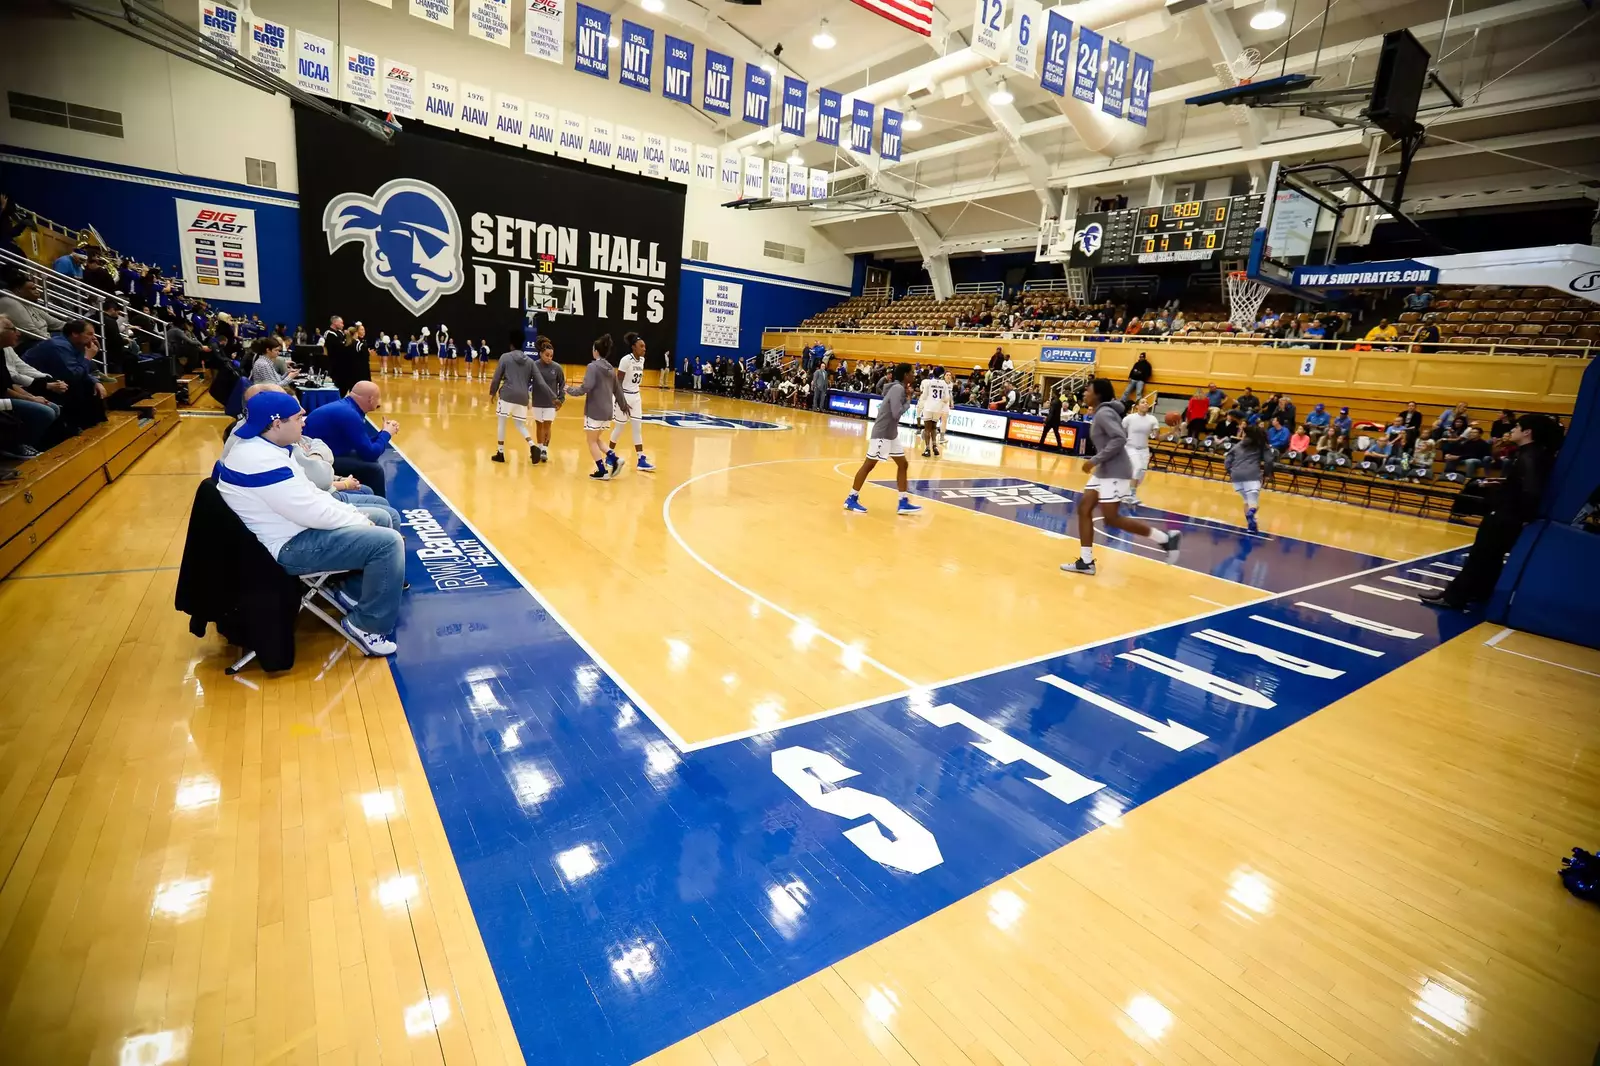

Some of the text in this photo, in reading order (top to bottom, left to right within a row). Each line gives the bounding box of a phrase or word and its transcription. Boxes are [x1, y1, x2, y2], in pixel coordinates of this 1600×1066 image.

[216, 6, 237, 23] BIG
[425, 9, 440, 21] 1993
[478, 7, 504, 23] BASKETBALL
[484, 3, 498, 14] MEN'S
[531, 2, 563, 17] EAST
[982, 0, 1001, 31] 12
[204, 14, 237, 34] EAST
[264, 22, 284, 39] BIG
[585, 17, 602, 31] 1941
[1019, 14, 1031, 46] 6
[253, 29, 284, 49] EAST
[578, 25, 607, 61] NIT
[630, 33, 646, 46] 1951
[977, 34, 997, 51] BROOKS
[1051, 30, 1067, 65] 12
[303, 41, 326, 55] 2014
[671, 48, 687, 61] 1952
[358, 54, 375, 67] BIG
[576, 55, 607, 72] FINAL FOUR
[623, 41, 650, 75] NIT
[1078, 43, 1098, 78] 24
[298, 57, 330, 83] NCAA
[348, 60, 375, 77] EAST
[391, 67, 411, 77] BIG
[711, 61, 727, 74] 1953
[1108, 57, 1125, 89] 34
[387, 72, 414, 83] EAST
[621, 69, 650, 86] FINAL FOUR
[666, 65, 691, 97] NIT
[706, 69, 730, 100] NIT
[1078, 75, 1095, 89] TERRY
[1133, 68, 1149, 97] 44
[297, 79, 330, 94] VOLLEYBALL
[425, 96, 454, 118] AIAW
[745, 91, 768, 120] NIT
[461, 105, 488, 127] AIAW
[783, 103, 805, 131] NIT
[496, 115, 522, 135] AIAW
[529, 123, 553, 143] AIAW
[819, 114, 839, 141] NIT
[560, 131, 583, 150] AIAW
[852, 123, 871, 149] NIT
[882, 132, 900, 157] NIT
[589, 138, 612, 157] AIAW
[616, 145, 639, 163] AIAW
[643, 145, 664, 163] NCAA
[669, 157, 690, 174] NCAA
[696, 163, 715, 179] NIT
[721, 168, 739, 184] NIT
[745, 173, 763, 188] WNIT
[769, 174, 786, 186] WNIT
[790, 182, 806, 196] NCAA
[811, 186, 826, 199] NCAA
[196, 209, 237, 224] BIG
[1173, 201, 1201, 218] 9:03
[1215, 207, 1226, 221] 0
[191, 219, 248, 234] EAST
[1149, 214, 1159, 229] 0
[471, 211, 666, 280] SETON HALL
[1146, 239, 1155, 253] 0
[1160, 238, 1169, 251] 4
[1184, 236, 1193, 250] 4
[1206, 234, 1216, 248] 0
[539, 261, 553, 274] 30
[1299, 269, 1432, 286] WWW.SHUPIRATES.COM
[472, 264, 666, 324] PIRATES
[916, 344, 921, 352] 4
[1052, 349, 1092, 358] PIRATE
[1304, 362, 1312, 373] 3
[932, 389, 942, 399] 31
[456, 539, 498, 568] HEALTH
[771, 601, 1425, 875] PIRATES
